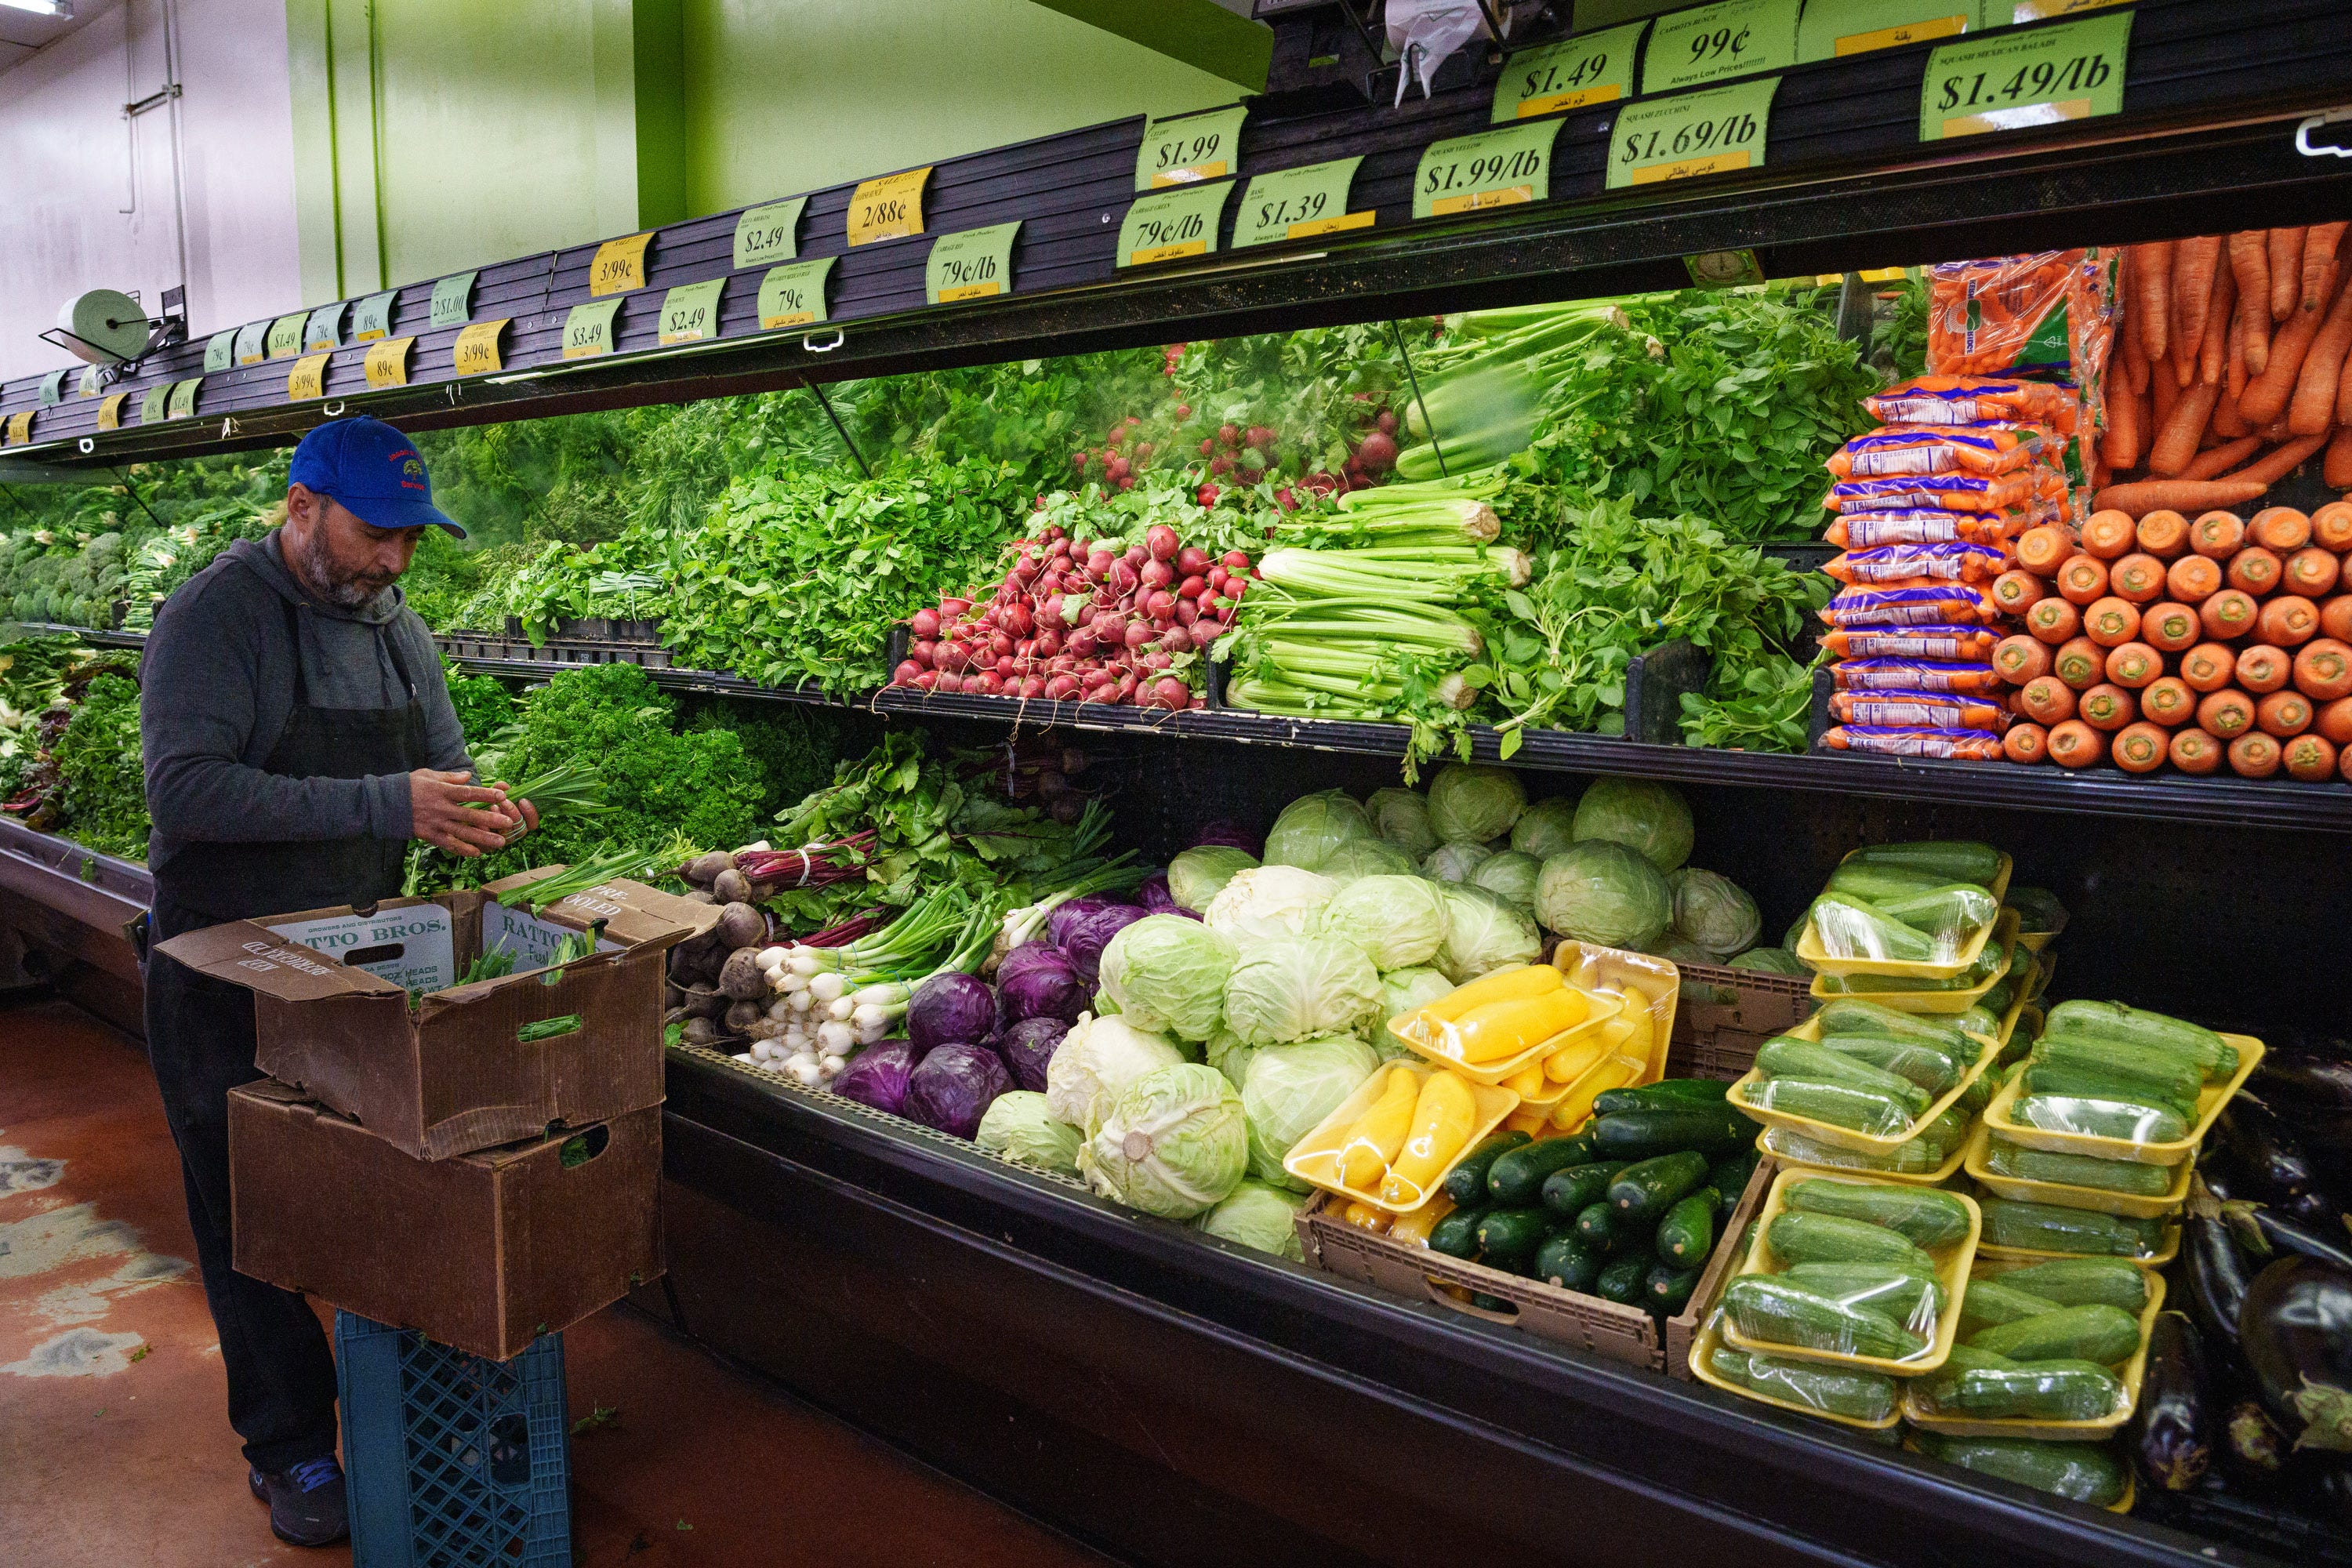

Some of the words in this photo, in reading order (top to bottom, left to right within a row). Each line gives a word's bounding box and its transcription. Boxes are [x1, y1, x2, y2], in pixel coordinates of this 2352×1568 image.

[1688, 24, 1751, 65] 99¢
[1521, 53, 1607, 100] $1.49
[1671, 74, 1699, 85] Always
[1700, 68, 1716, 78] Low
[1937, 53, 2110, 112] $1.49/lb
[1627, 111, 1654, 123] SQUASH
[1654, 105, 1690, 118] ZUCCHINI
[1456, 143, 1480, 151] YELLOW
[1621, 113, 1757, 165] $1.69/lb
[1156, 134, 1220, 169] $1.99
[876, 177, 902, 187] SALE
[1425, 148, 1540, 195] $1.99/lb
[862, 199, 906, 227] 2/88¢
[1257, 192, 1327, 230] $1.39
[746, 227, 784, 253] $2.49
[1136, 213, 1203, 247] 79¢/lb
[601, 259, 632, 281] 3/99¢
[942, 255, 996, 287] 79¢/lb
[434, 294, 465, 317] 2/$1.00
[779, 289, 803, 313] 79¢
[364, 314, 377, 330] 89¢
[670, 307, 705, 332] $2.49
[274, 332, 296, 348] $1.49
[316, 324, 328, 339] 79¢
[572, 323, 602, 347] $3.49
[212, 349, 223, 361] 79¢
[464, 342, 489, 362] 3/99¢
[377, 361, 393, 377] 89¢
[295, 374, 314, 390] 3/99¢
[174, 395, 189, 409] $1.49
[1873, 454, 1878, 463] 35
[1874, 566, 1878, 575] 35
[588, 884, 629, 901] PRE-
[563, 894, 622, 916] OOLED
[358, 916, 402, 927] DISTRIBUTORS
[303, 932, 359, 950] TTO
[373, 919, 446, 942] BROS.
[405, 966, 437, 977] HEADS
[405, 976, 438, 987] HEADS
